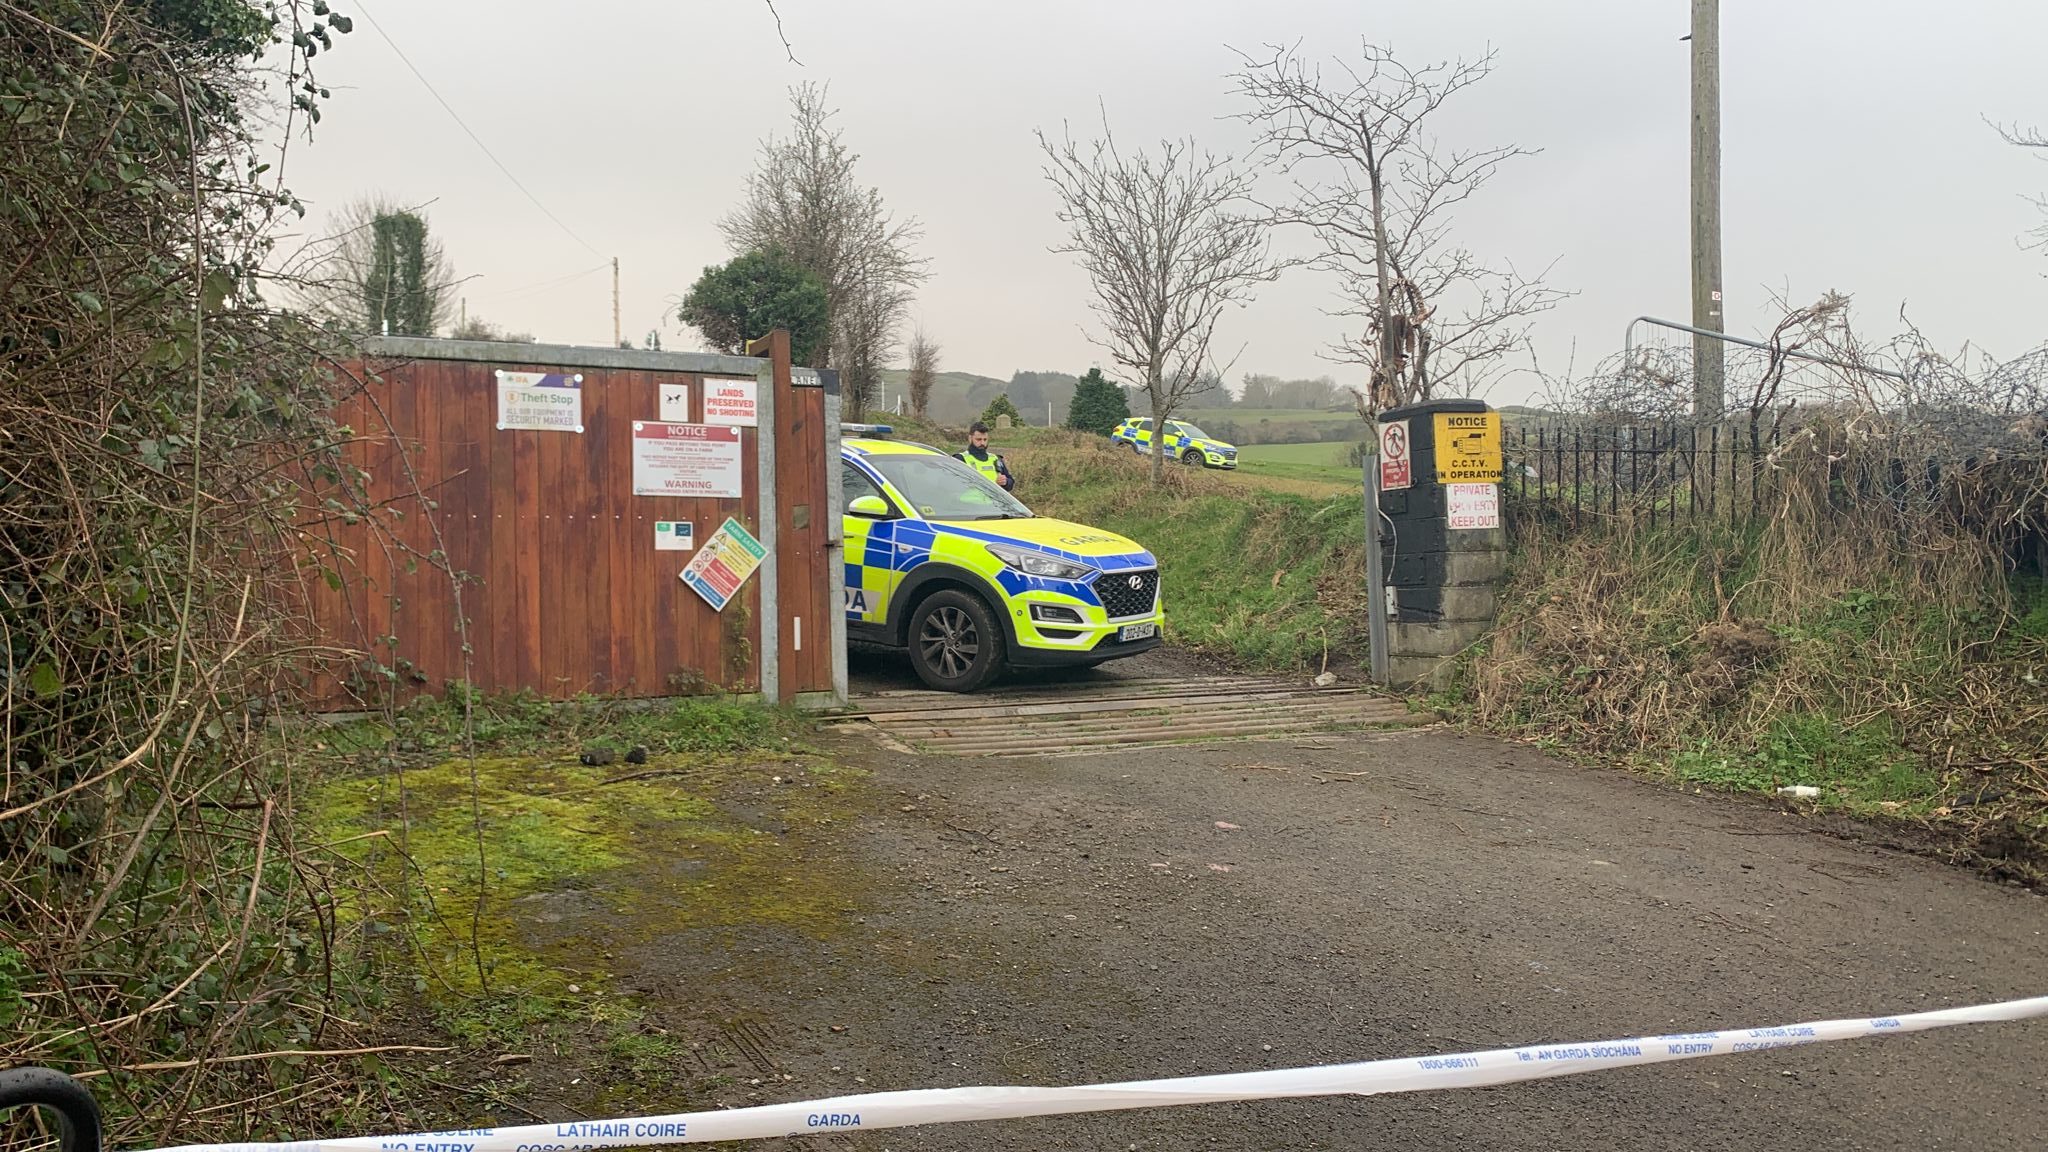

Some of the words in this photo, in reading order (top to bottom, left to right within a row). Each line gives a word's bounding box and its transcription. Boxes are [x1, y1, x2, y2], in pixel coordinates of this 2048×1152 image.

[521, 392, 548, 403] Theft
[551, 394, 573, 405] Stop
[717, 388, 745, 398] LANDS
[707, 398, 754, 408] PRESERVED
[719, 409, 755, 417] SHOOTING
[506, 415, 541, 425] SECURITY
[543, 416, 574, 426] MARKED
[1448, 417, 1487, 426] NOTICE
[667, 425, 708, 437] NOTICE
[1452, 459, 1488, 468] C.C.T.V.
[1450, 470, 1503, 478] OPERATION
[664, 480, 712, 489] WARNING
[1453, 485, 1491, 496] PRIVATE
[1451, 516, 1474, 527] KEEP
[1477, 516, 1496, 527] OUT
[1748, 1028, 1786, 1038] LATHAIR
[1788, 1027, 1816, 1036] COIRE
[1668, 1045, 1682, 1054] NO
[1684, 1043, 1713, 1054] ENTRY
[1515, 1051, 1533, 1062] Tel.
[1538, 1050, 1552, 1061] AN
[1555, 1048, 1591, 1060] GARDA
[1417, 1057, 1479, 1070] 1800-666111
[807, 1113, 861, 1127] GARDA
[557, 1123, 630, 1137] LATHAIR
[635, 1123, 687, 1137] COIRE
[415, 1143, 475, 1152] ENTRY
